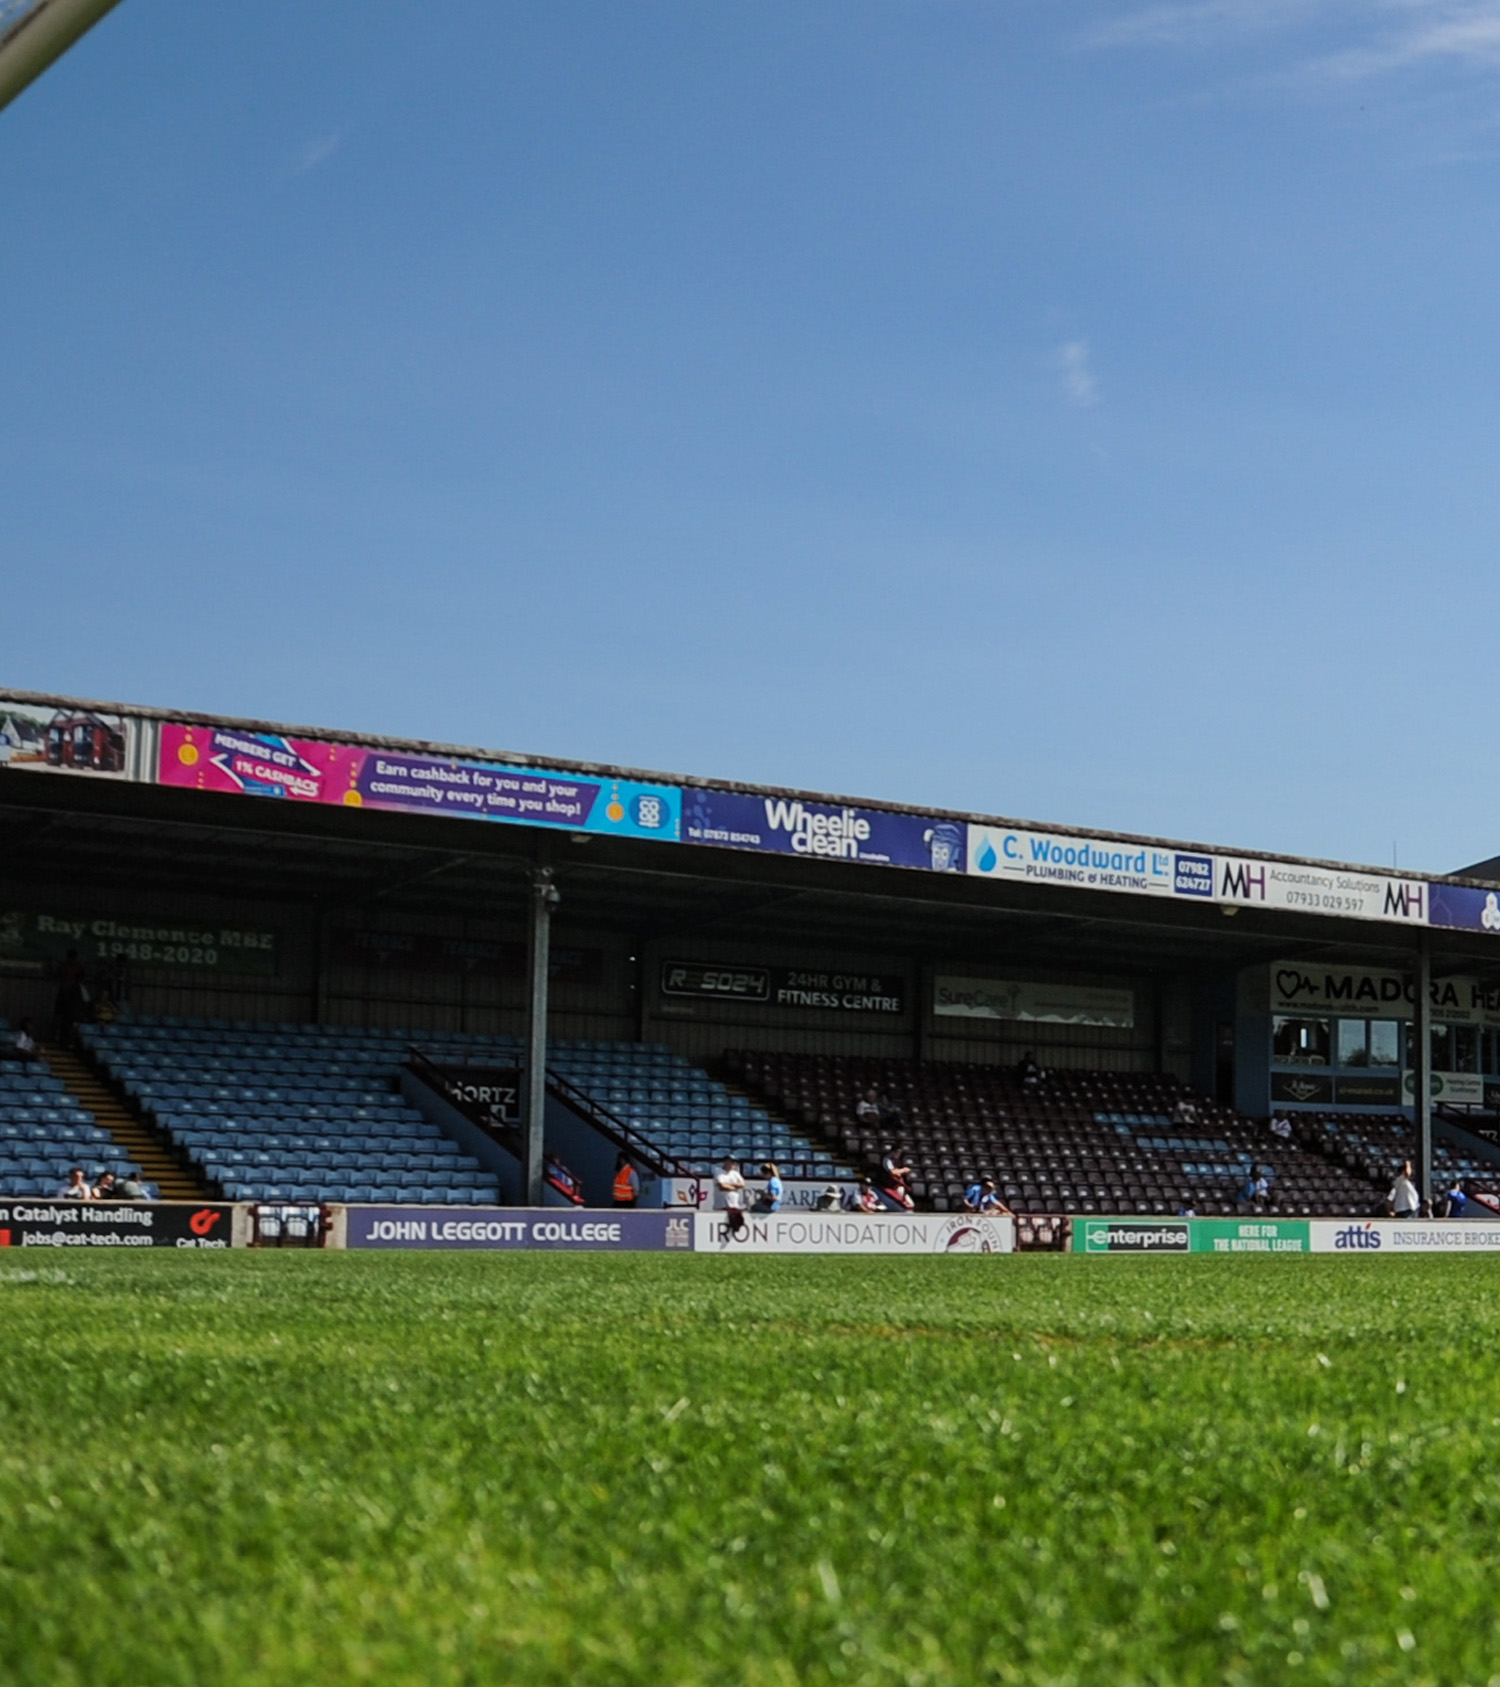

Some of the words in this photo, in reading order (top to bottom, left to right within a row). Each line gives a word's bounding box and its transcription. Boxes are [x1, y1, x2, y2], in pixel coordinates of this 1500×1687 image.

[214, 733, 271, 760] MEMBERS
[272, 750, 297, 768] GET
[254, 766, 319, 792] CASHBACK
[376, 761, 407, 778] Earn
[411, 765, 470, 786] cashback
[473, 770, 492, 787] for
[495, 776, 519, 792] you
[522, 777, 546, 794] and
[549, 783, 579, 800] your
[371, 780, 444, 801] community
[447, 788, 484, 808] every
[487, 790, 516, 807] time
[519, 797, 543, 813] you
[546, 799, 581, 818] shop!
[764, 798, 870, 841] Wheelie
[791, 831, 858, 859] clean
[1003, 835, 1023, 860] C.
[1030, 837, 1146, 873] Woodward
[1026, 865, 1085, 883] PLUMBING
[1101, 873, 1147, 889] HEATING
[1222, 861, 1265, 901] MH
[1270, 869, 1333, 891] Accountancy
[1336, 875, 1380, 894] Solutions
[1286, 891, 1321, 906] 07933
[1384, 881, 1423, 919] MH
[37, 914, 86, 940] Ray
[92, 917, 215, 945] Clemence
[95, 941, 218, 965] 1948-2020
[787, 971, 828, 988] 24HR
[832, 974, 867, 992] GYM
[871, 977, 882, 993] &
[777, 988, 840, 1009] FITNESS
[842, 994, 901, 1013] CENTRE
[12, 1205, 79, 1225] Catalyst
[81, 1206, 154, 1227] Handling
[665, 1218, 689, 1231] JLC
[946, 1215, 972, 1233] IRON
[22, 1230, 153, 1248] jobs@cat-tech.com
[366, 1222, 427, 1241] JOHN
[432, 1222, 527, 1241] LEGGOTT
[533, 1223, 621, 1242] COLLEGE
[709, 1222, 768, 1243] IRON
[776, 1222, 927, 1245] FOUNDATION
[1091, 1228, 1187, 1248] enterprise
[1238, 1225, 1260, 1238] HERE
[1262, 1225, 1277, 1238] FOR
[1393, 1232, 1463, 1246] INSURANCE
[1214, 1239, 1229, 1251] THE
[1231, 1239, 1270, 1252] NATIONAL
[1272, 1239, 1302, 1252] LEAGUE
